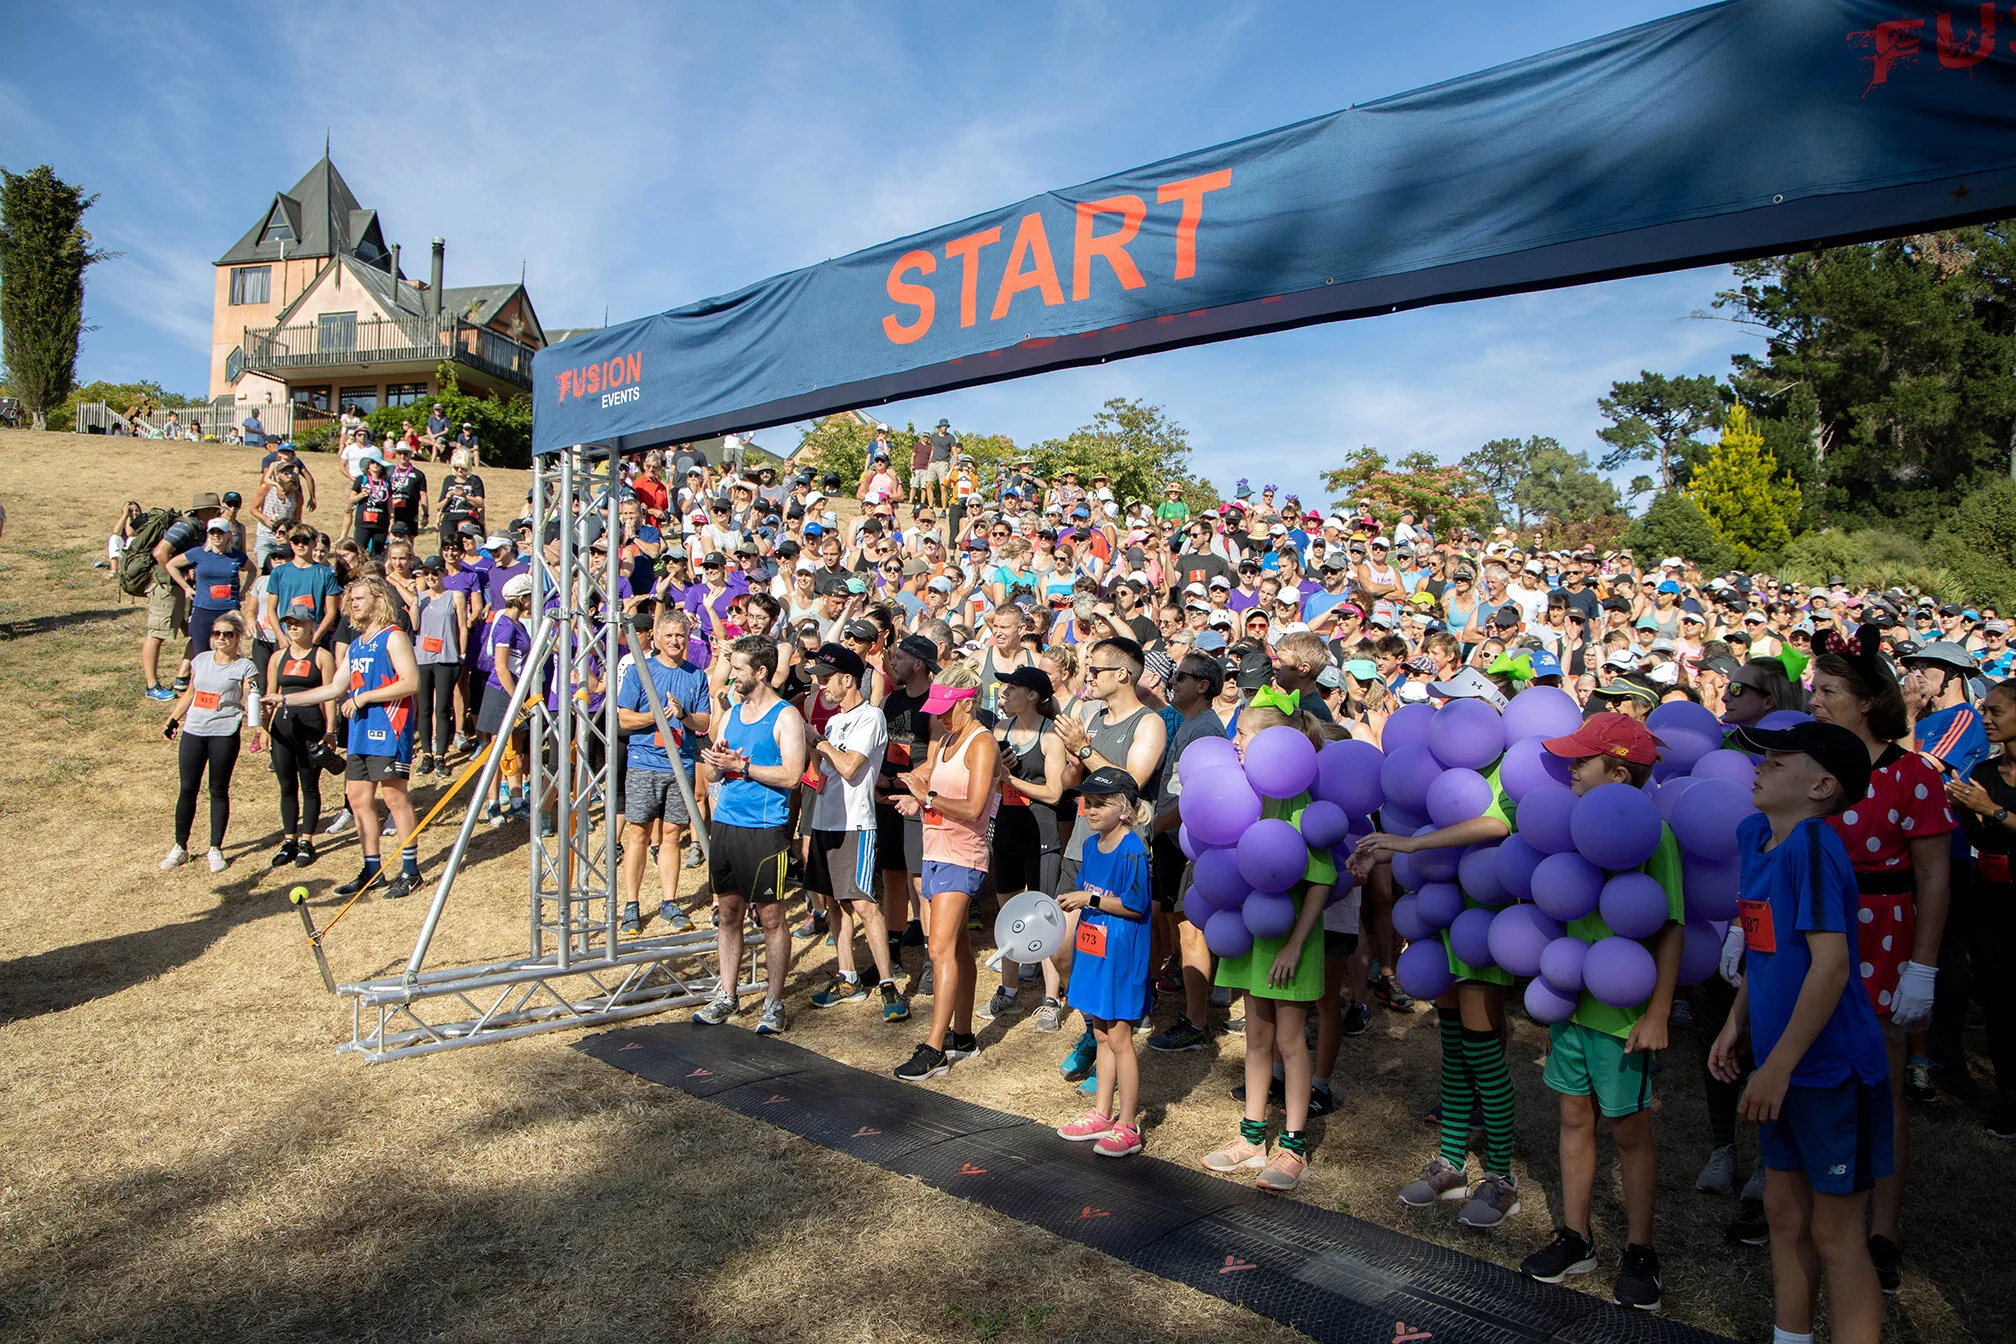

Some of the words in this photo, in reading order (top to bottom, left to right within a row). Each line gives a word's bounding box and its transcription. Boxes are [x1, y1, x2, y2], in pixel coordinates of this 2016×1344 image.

[1846, 1, 2016, 97] FU
[882, 168, 1232, 345] START
[555, 351, 642, 407] FUSION
[601, 386, 640, 409] EVENTS
[1094, 776, 1113, 785] 2XU
[1081, 931, 1096, 945] 473
